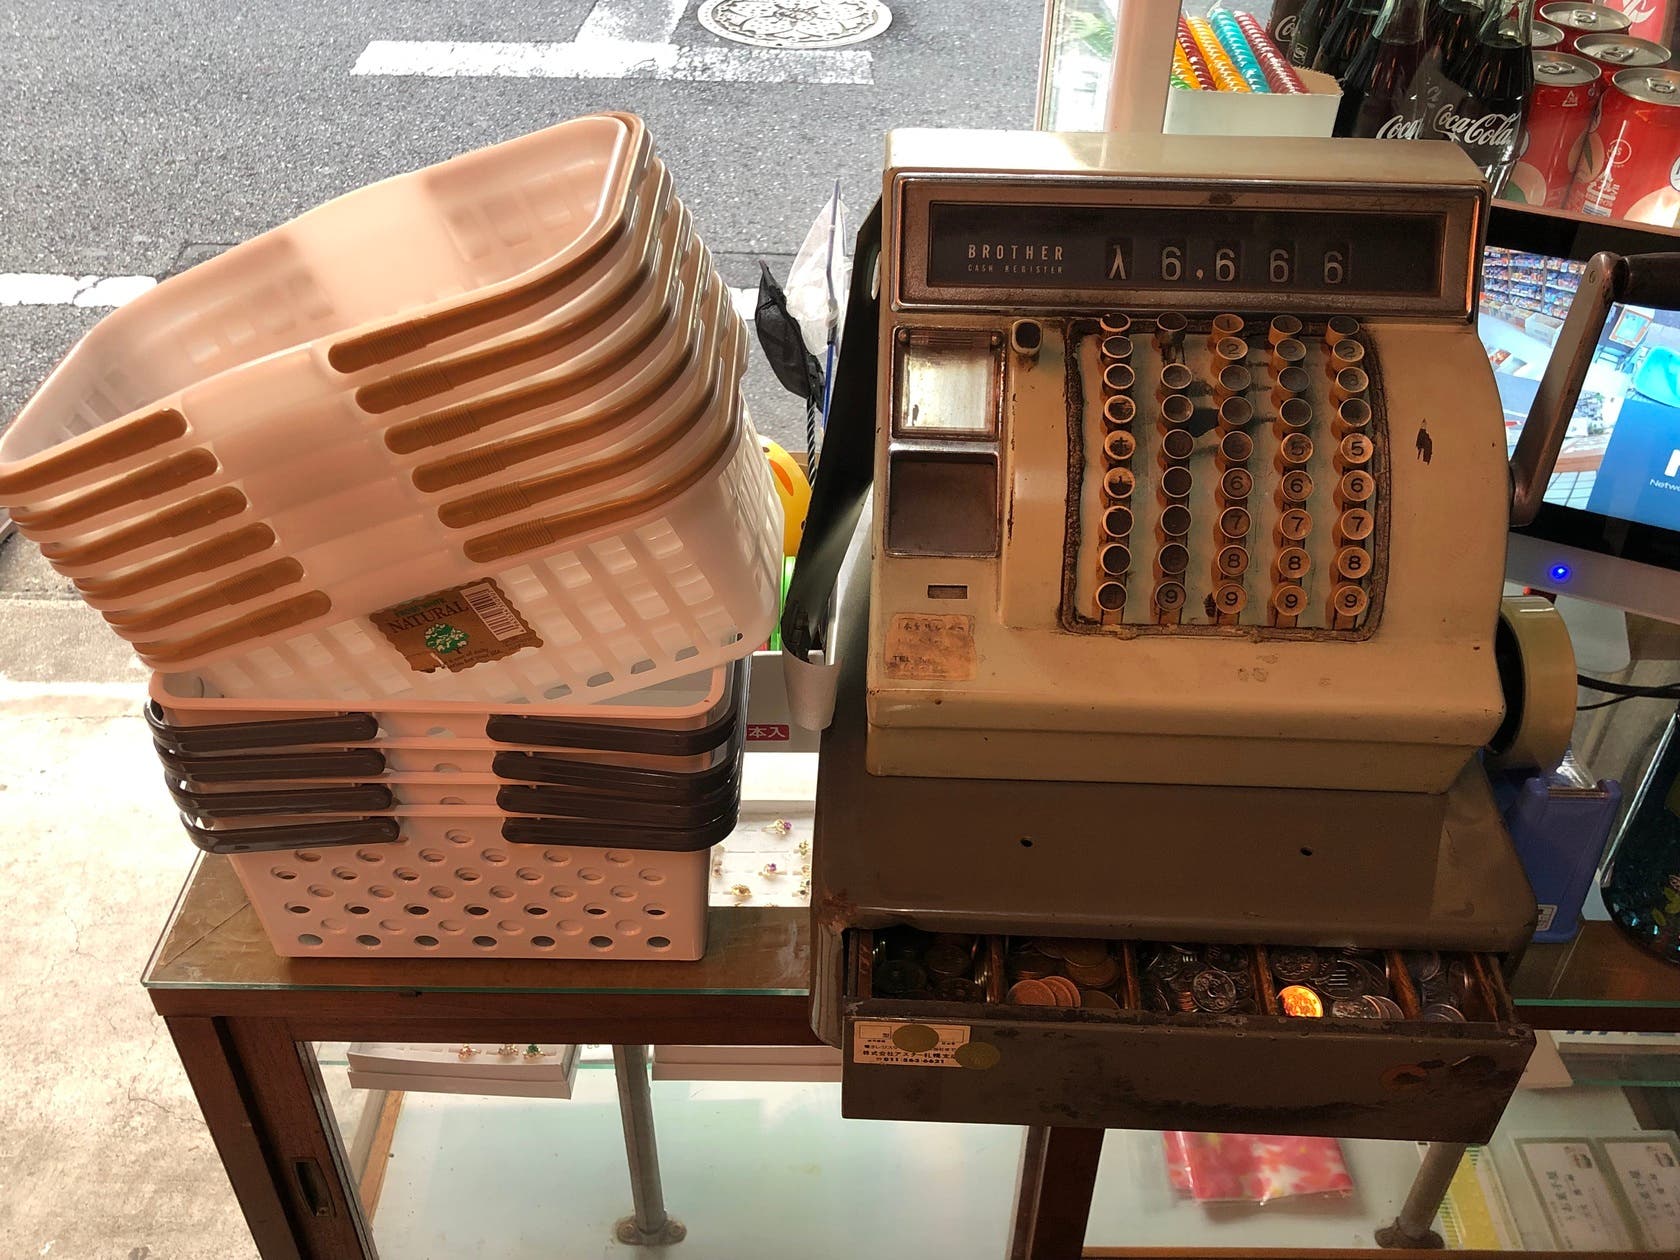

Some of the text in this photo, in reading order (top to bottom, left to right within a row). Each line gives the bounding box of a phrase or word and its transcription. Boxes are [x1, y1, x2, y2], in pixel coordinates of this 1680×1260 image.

[968, 244, 1063, 261] BROTHER
[968, 264, 1063, 274] CASH REGISTER
[1228, 344, 1239, 354] 2
[1351, 442, 1365, 456] 5
[1231, 477, 1243, 490] 6
[1290, 479, 1303, 493] 6
[1351, 479, 1363, 492] 6
[1230, 516, 1242, 529] 7
[1290, 517, 1303, 531] 7
[1351, 517, 1365, 531] 7
[1228, 554, 1240, 568] 8
[1288, 556, 1301, 570] 8
[1348, 556, 1361, 569] 8
[1166, 591, 1177, 603] 9
[1225, 592, 1237, 605] 9
[1285, 594, 1298, 607] 9
[1344, 594, 1358, 607] 9
[387, 599, 470, 634] NATURAL
[748, 726, 786, 738] 本入
